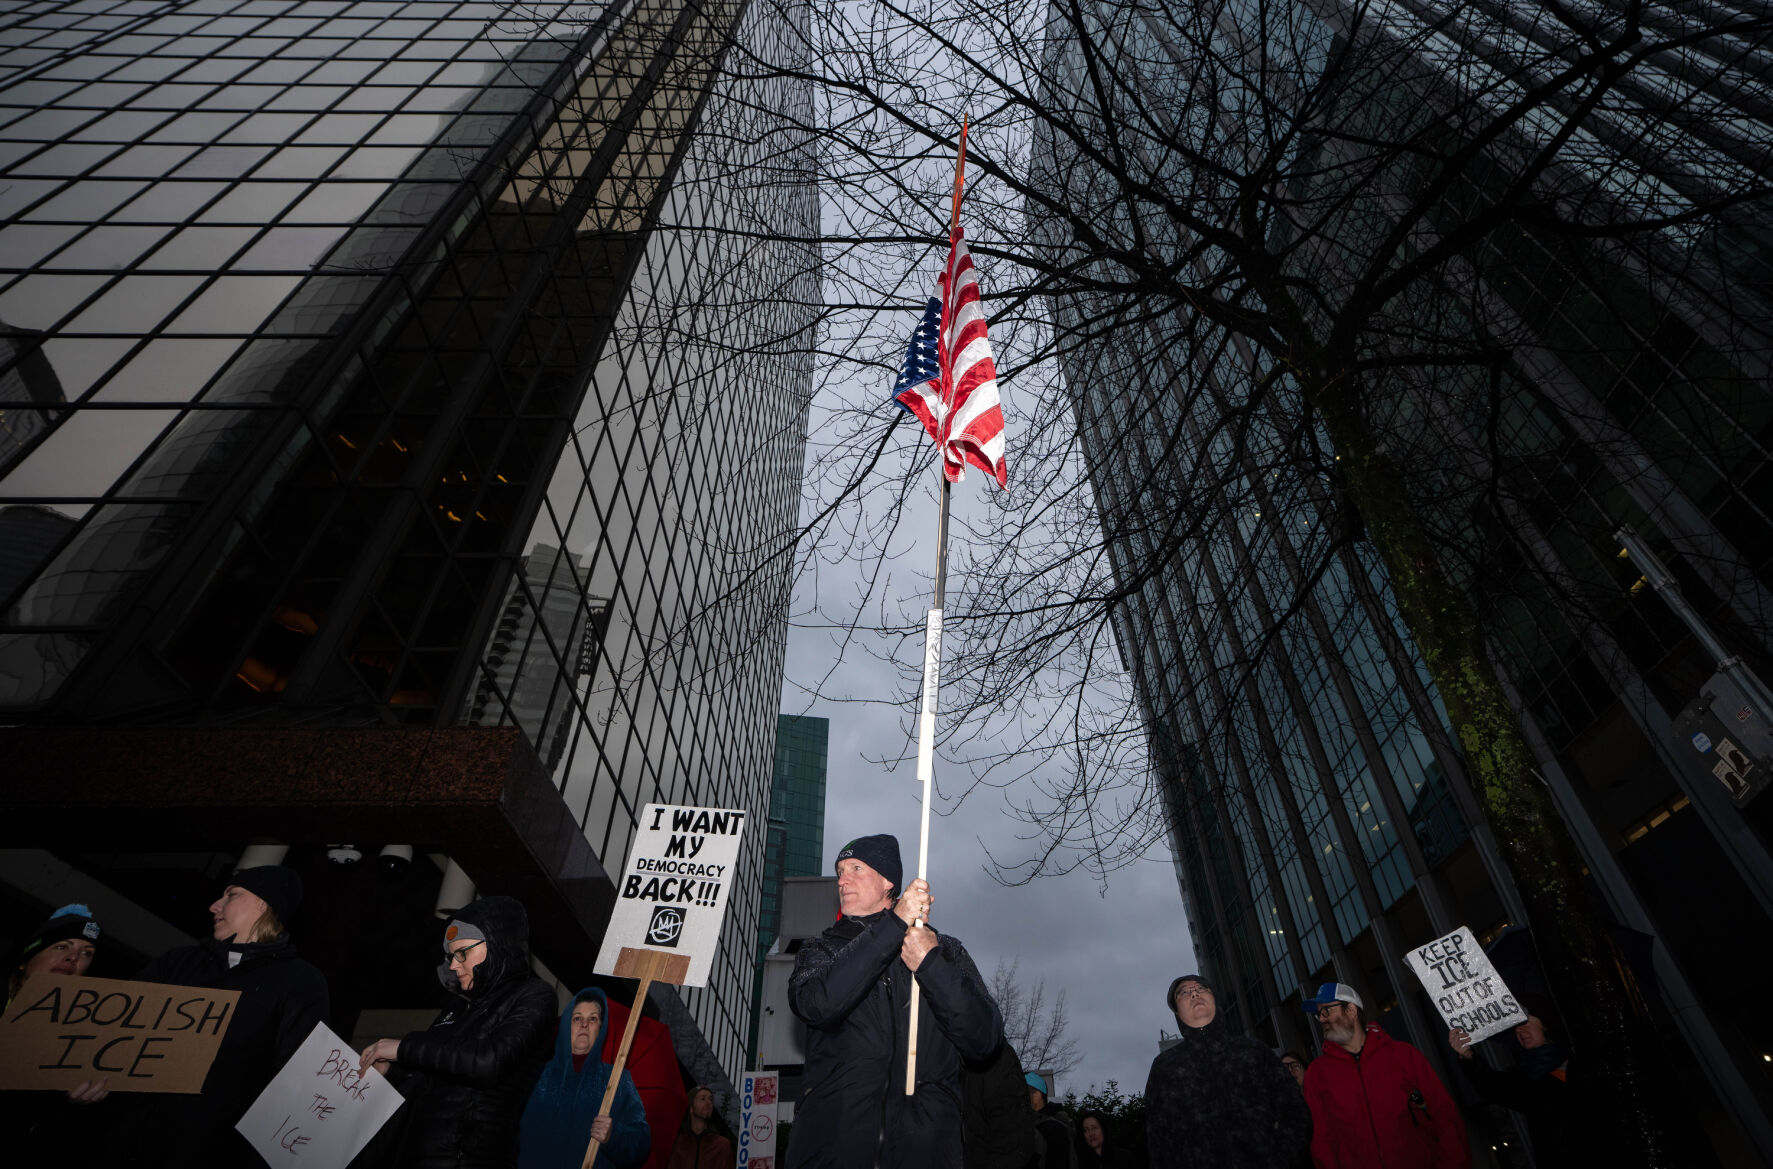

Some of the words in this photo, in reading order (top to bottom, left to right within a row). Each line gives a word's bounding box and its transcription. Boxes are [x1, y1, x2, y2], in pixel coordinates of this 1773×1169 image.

[649, 808, 665, 830] I
[671, 809, 745, 835] WANT
[664, 834, 705, 859] MY
[636, 858, 726, 878] DEMOCRACY
[622, 874, 721, 907] BACK!!!
[1418, 934, 1463, 966] KEEP
[1430, 951, 1479, 990] ICE
[11, 986, 231, 1035] ABOLISH
[1438, 985, 1474, 1014] OUT
[1472, 976, 1495, 1000] OF
[1449, 994, 1520, 1034] SCHOOLS
[38, 1034, 173, 1078] ICE
[316, 1048, 371, 1102] BREAK
[307, 1092, 337, 1121] THE
[738, 1078, 753, 1169] BOYCO
[271, 1114, 312, 1155] ICE
